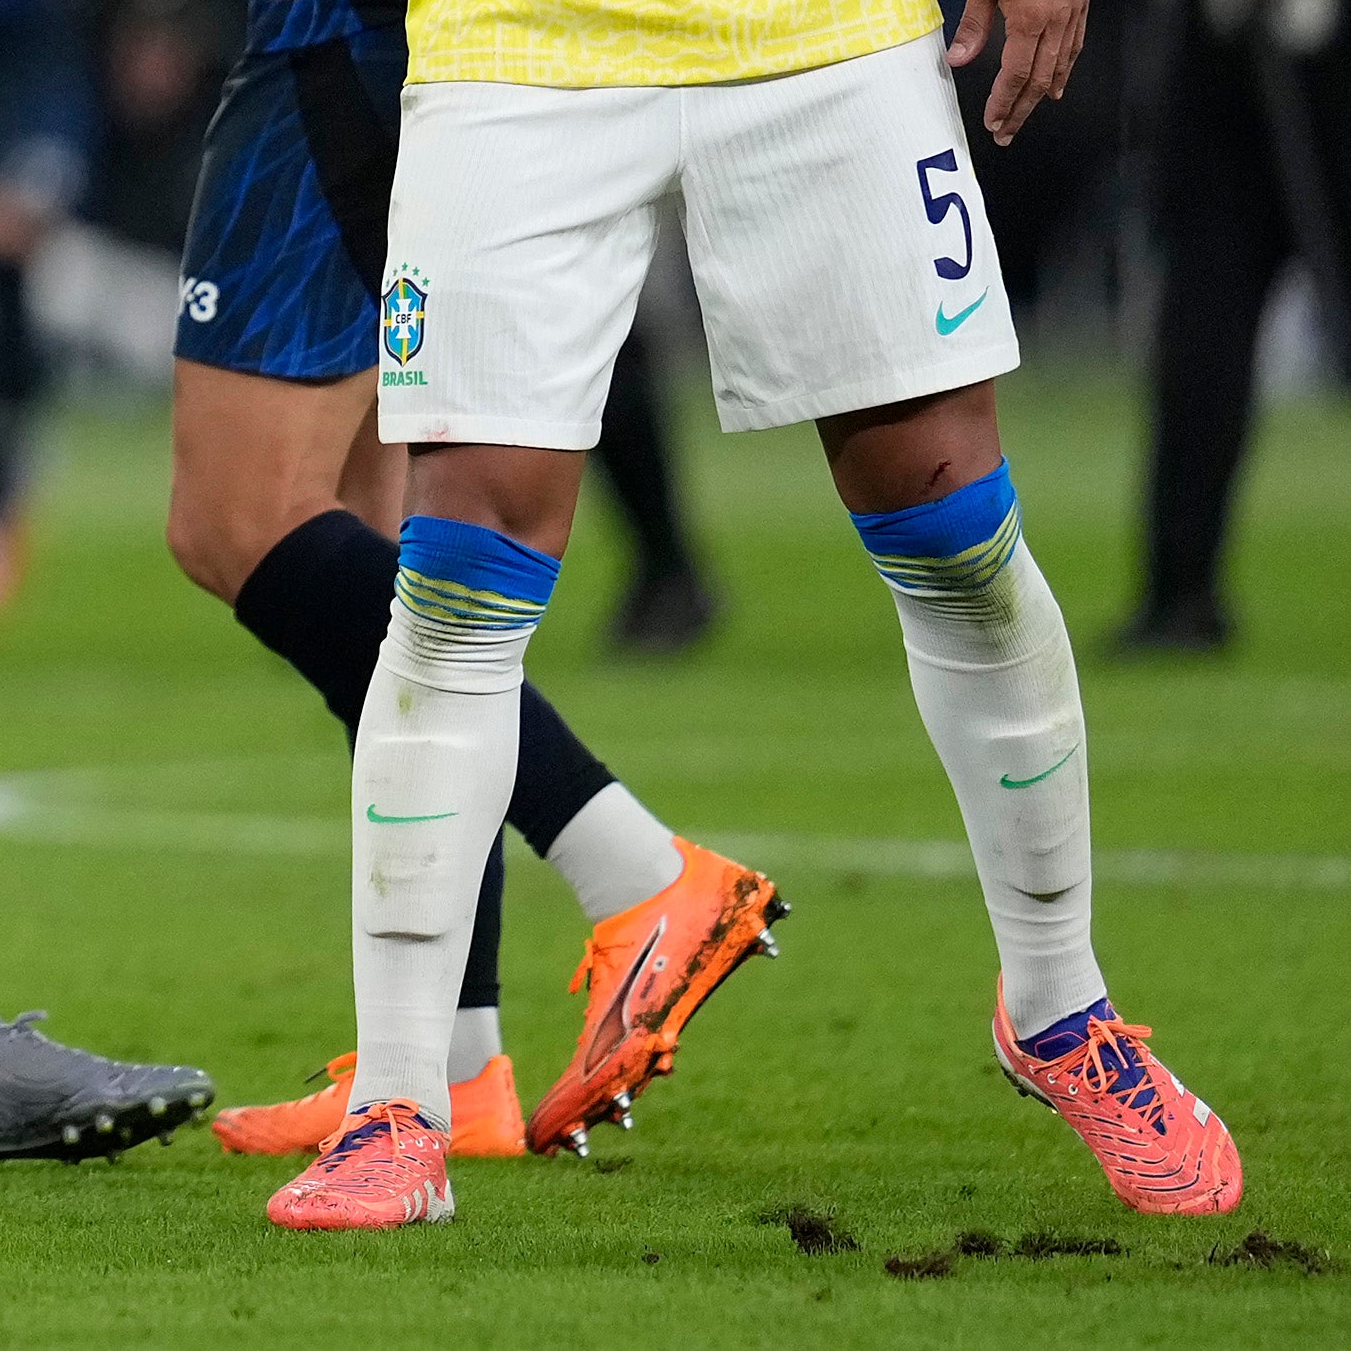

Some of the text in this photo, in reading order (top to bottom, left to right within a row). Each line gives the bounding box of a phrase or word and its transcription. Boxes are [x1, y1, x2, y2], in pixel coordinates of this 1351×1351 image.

[916, 147, 973, 281] 5
[395, 313, 412, 325] CBF
[382, 370, 428, 387] BRASIL
